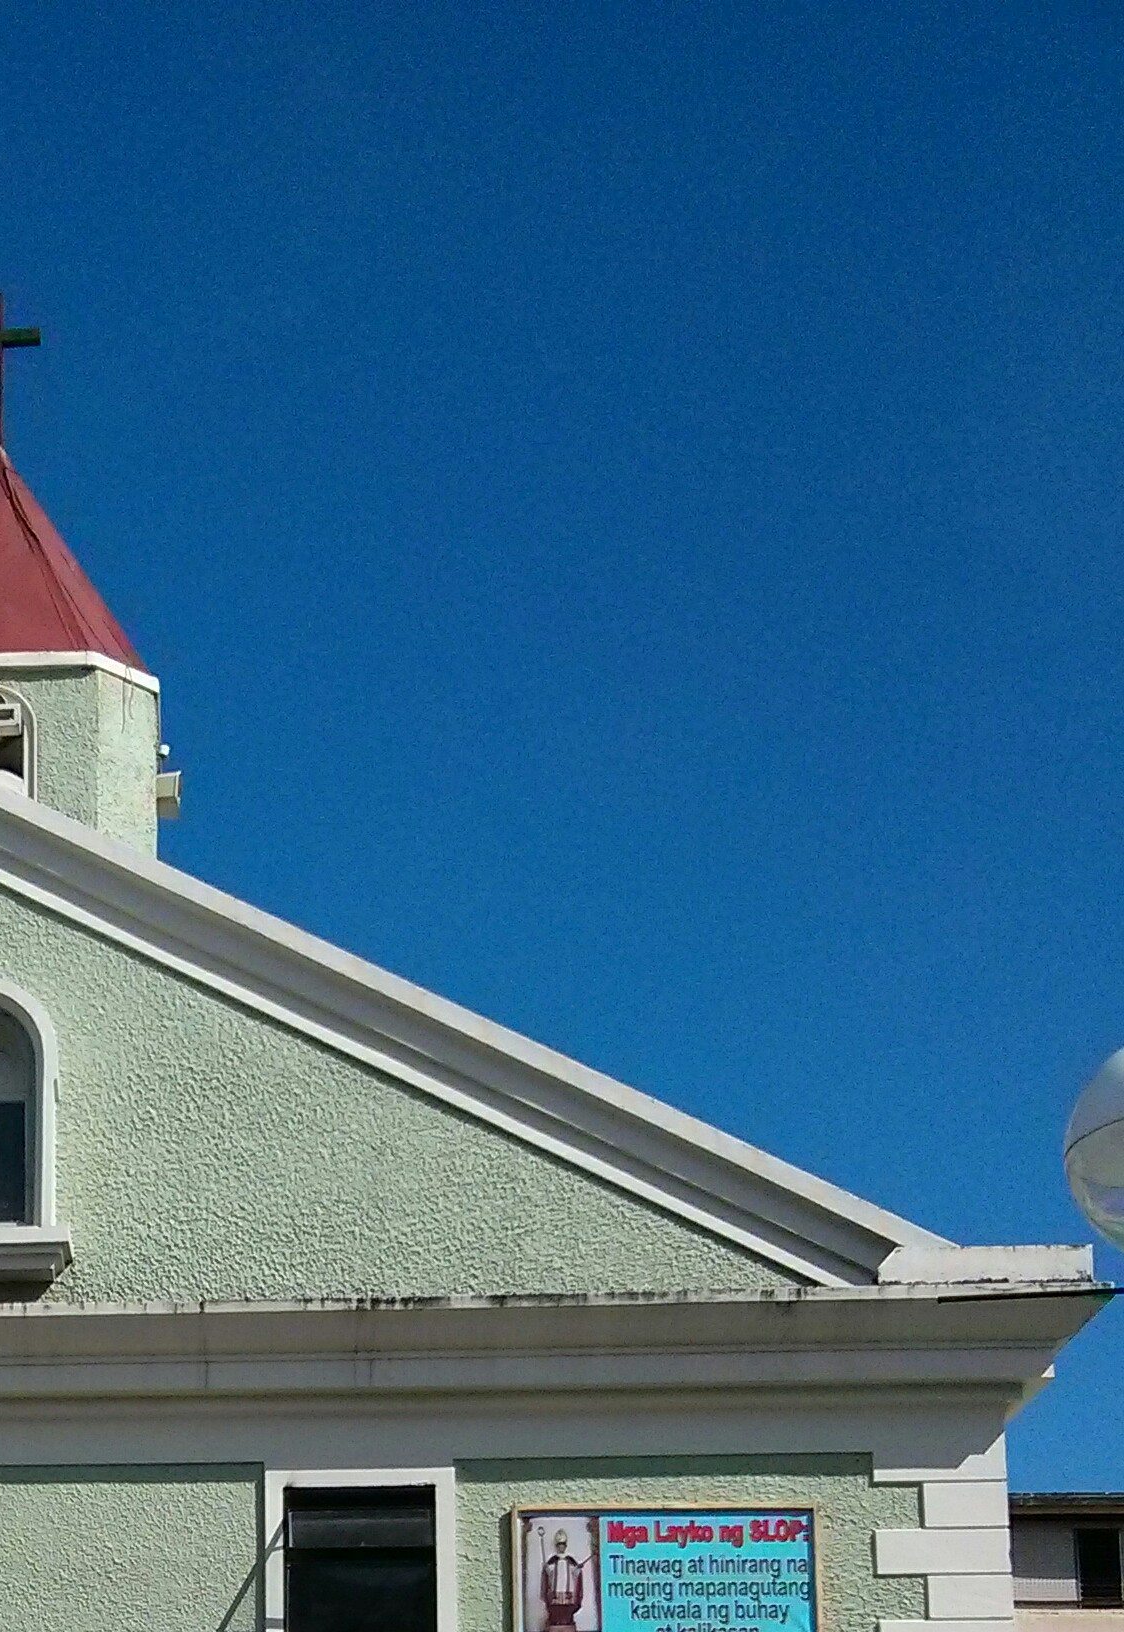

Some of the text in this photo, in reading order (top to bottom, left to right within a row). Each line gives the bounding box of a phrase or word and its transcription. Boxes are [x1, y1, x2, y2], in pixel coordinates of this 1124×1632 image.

[607, 1521, 649, 1549] Mga
[654, 1520, 714, 1549] Layko
[719, 1525, 744, 1548] ng
[609, 1554, 808, 1578] Tinawag at hinirang na
[607, 1577, 810, 1602] maging mapanagutang
[631, 1599, 790, 1624] katiwala ng buhay
